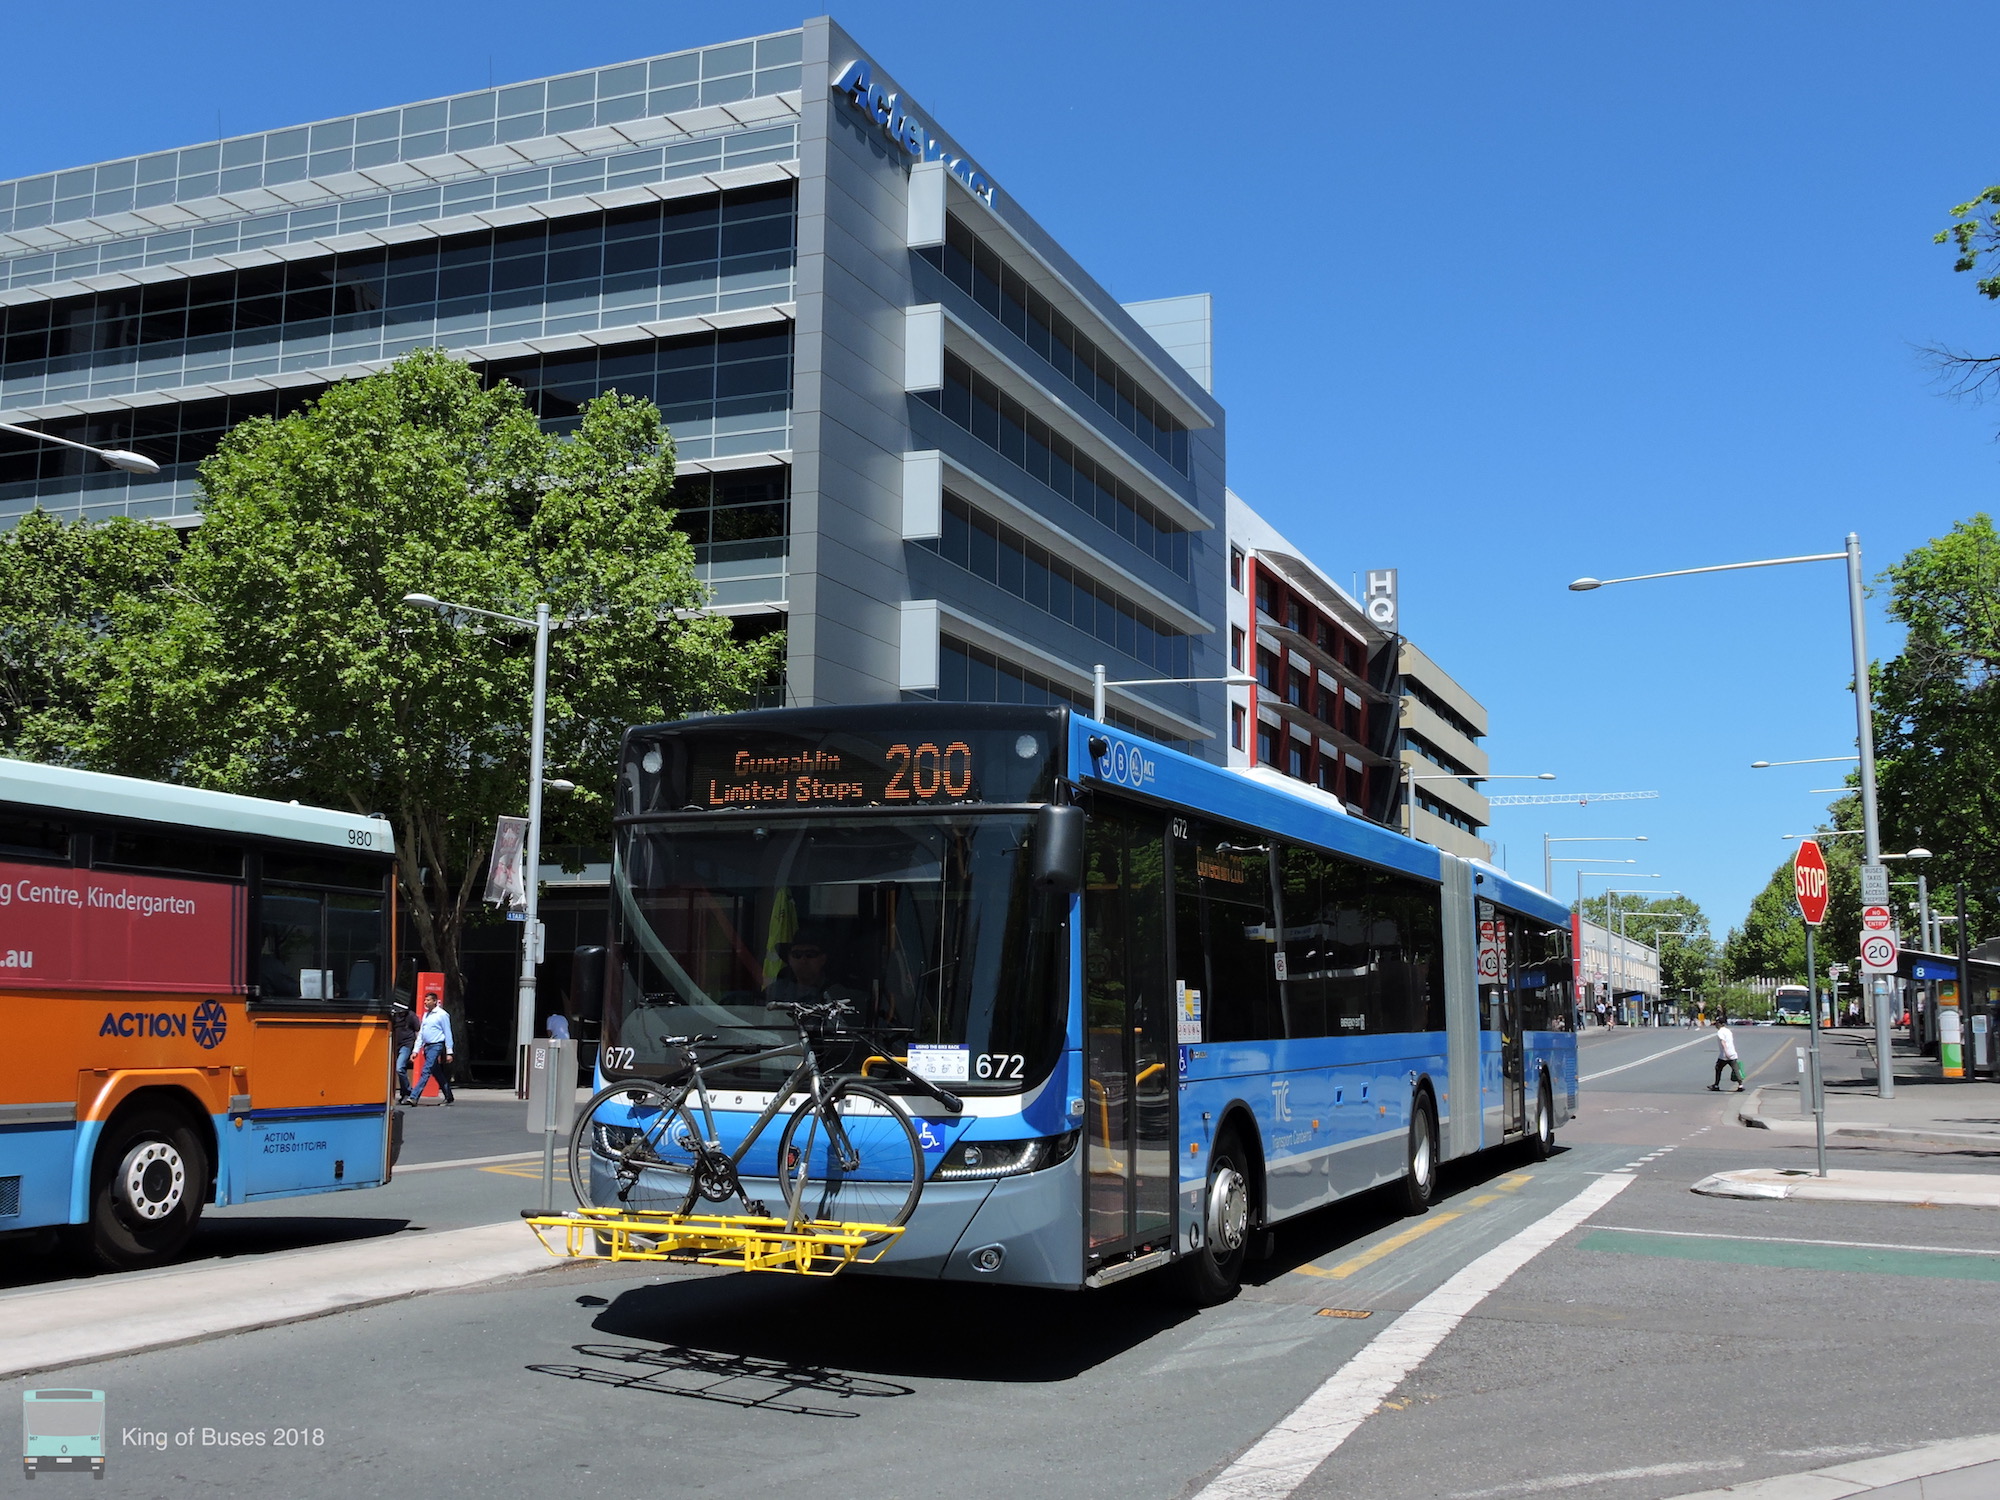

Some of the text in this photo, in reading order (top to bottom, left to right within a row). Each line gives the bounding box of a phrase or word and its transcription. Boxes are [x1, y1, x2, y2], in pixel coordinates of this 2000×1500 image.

[1369, 571, 1394, 623] HQ
[735, 750, 841, 776] Gungahlin
[885, 741, 972, 799] 200
[709, 776, 863, 804] Limited Stops
[347, 829, 373, 847] 980
[1172, 817, 1188, 839] 672
[1797, 866, 1825, 898] STOP
[17, 880, 83, 909] Centre,
[87, 886, 196, 917] Kindergarten
[0, 949, 33, 968] .au
[1868, 945, 1889, 958] 20
[1916, 967, 1925, 977] 8
[99, 1011, 187, 1038] ACTION
[605, 1046, 635, 1070] 672
[975, 1053, 1025, 1079] 672
[709, 1093, 881, 1109] VOLGEN
[264, 1132, 296, 1142] ACTION
